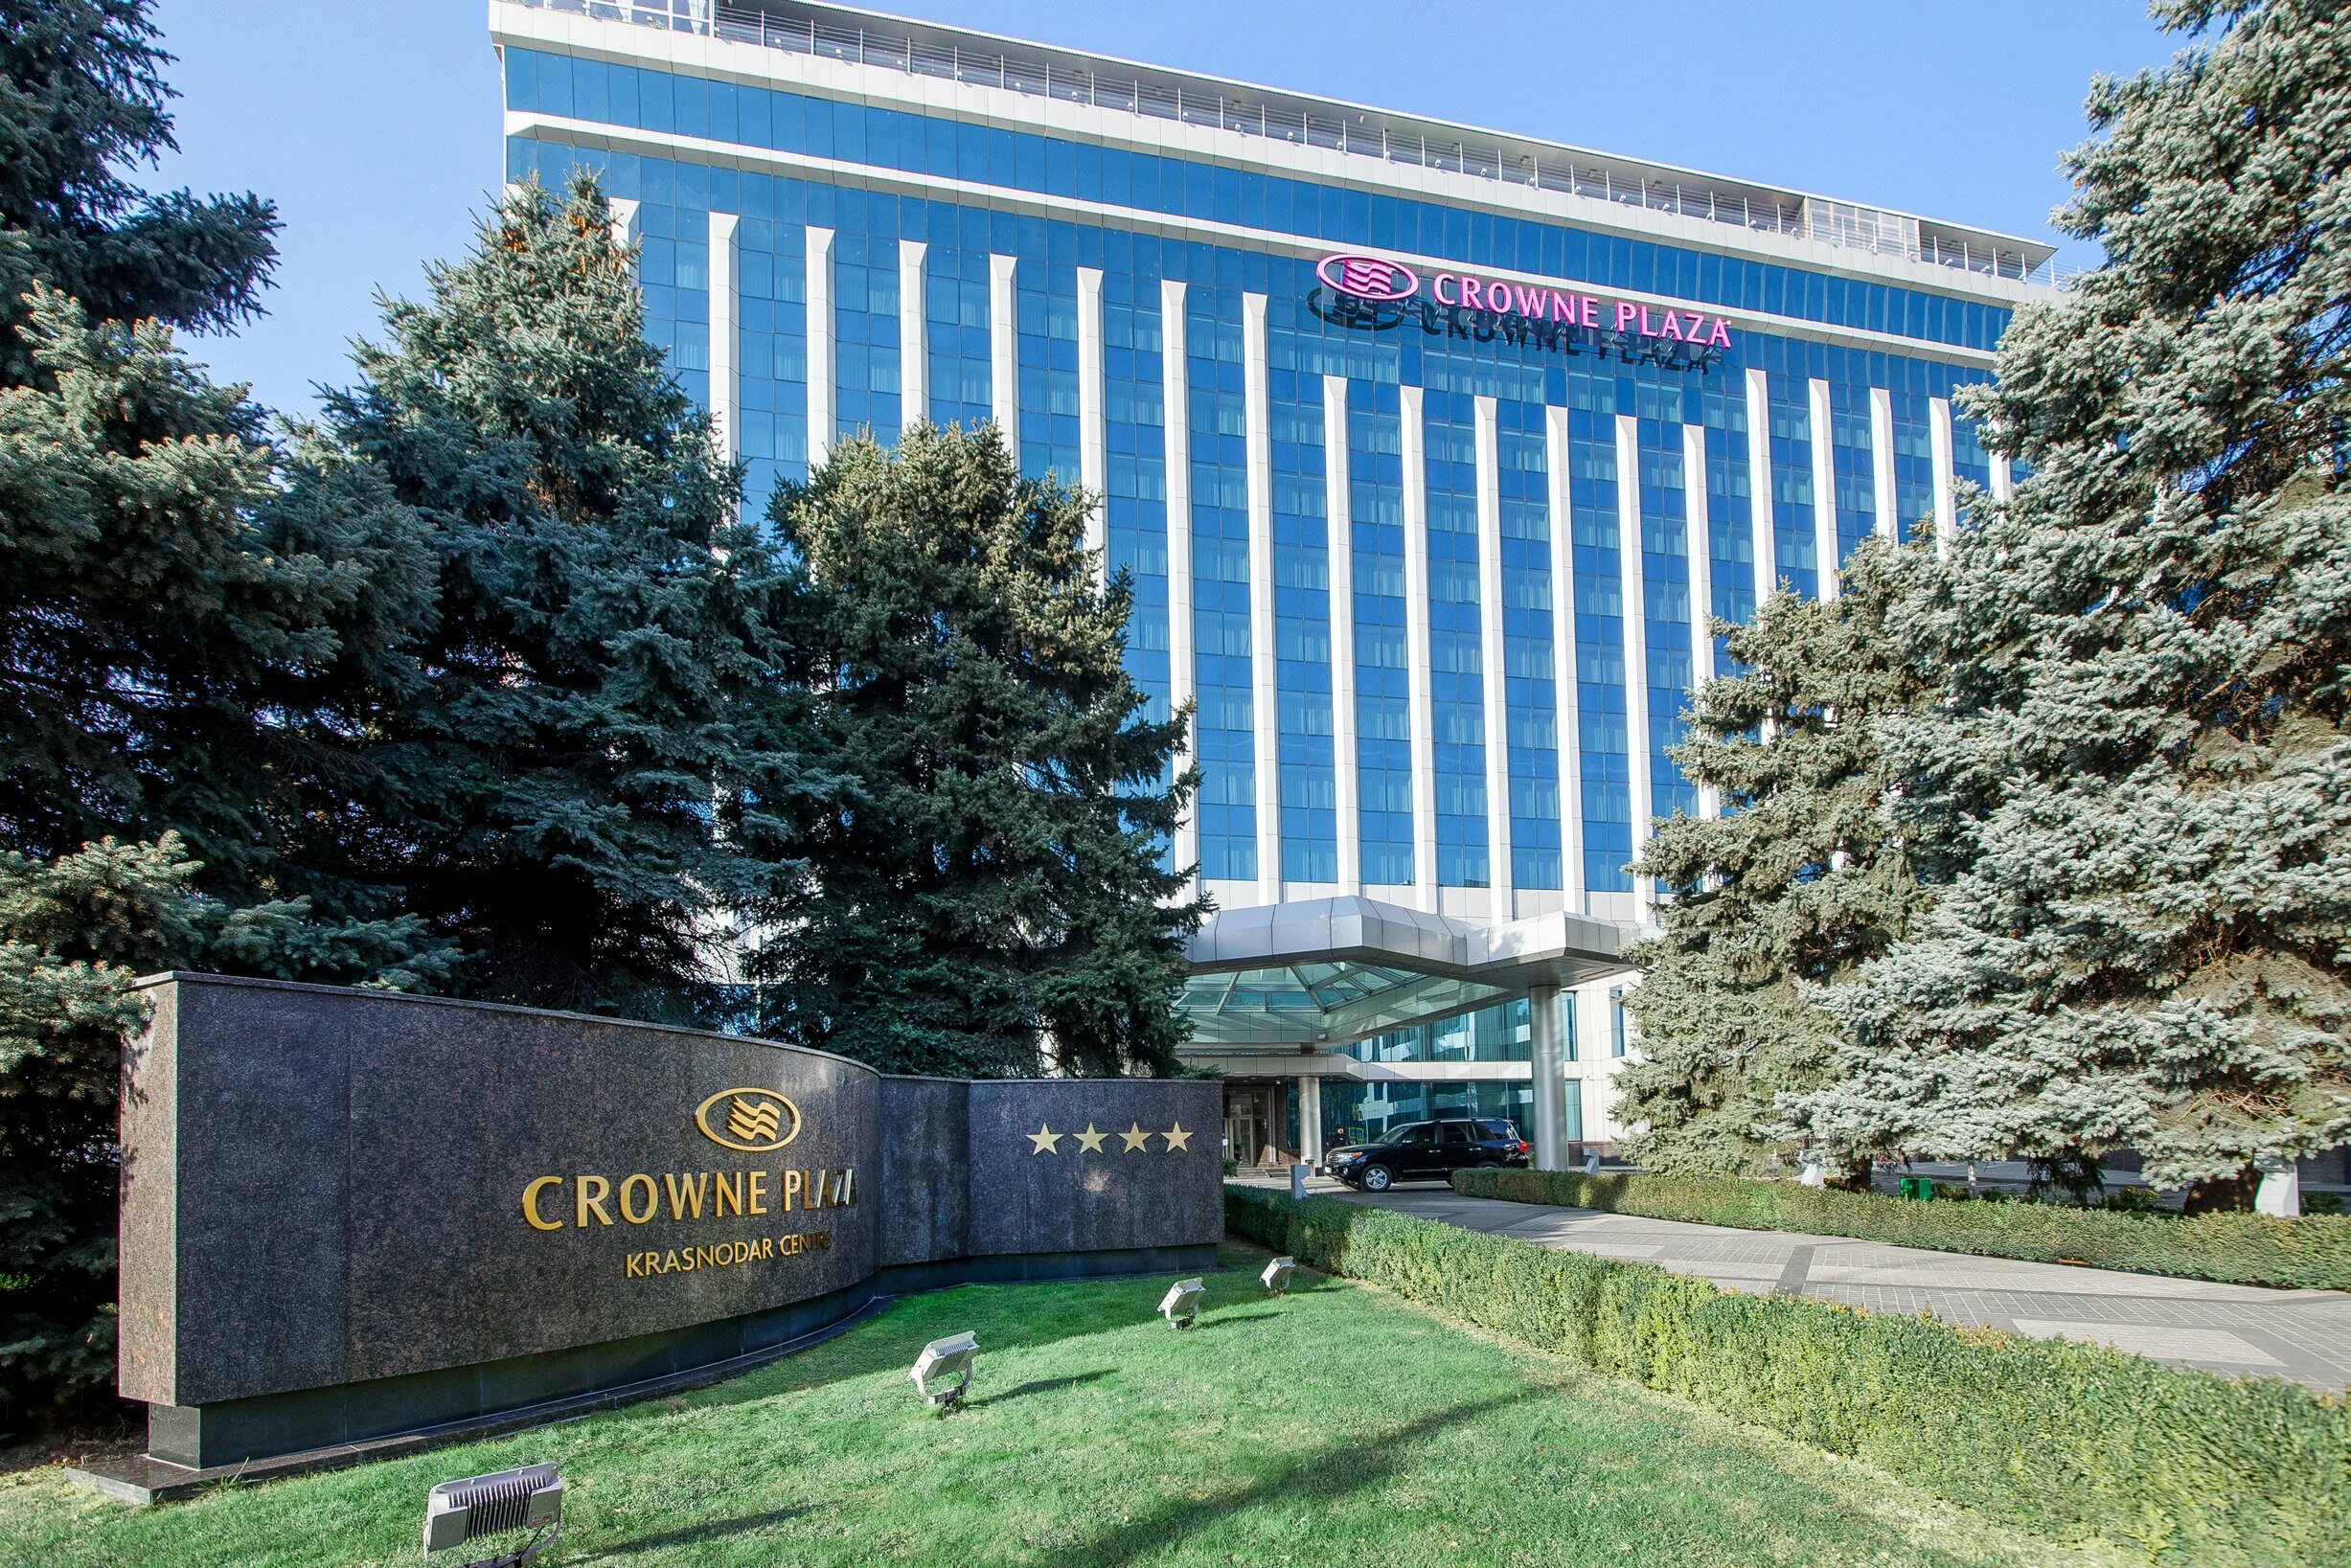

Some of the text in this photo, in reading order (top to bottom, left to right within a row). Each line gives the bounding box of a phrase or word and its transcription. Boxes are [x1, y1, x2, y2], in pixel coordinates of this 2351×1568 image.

[1433, 273, 1732, 349] CROWNE PLAZA
[521, 1169, 857, 1231] CROWNE PLAZA
[626, 1238, 773, 1278] KRASNODAR
